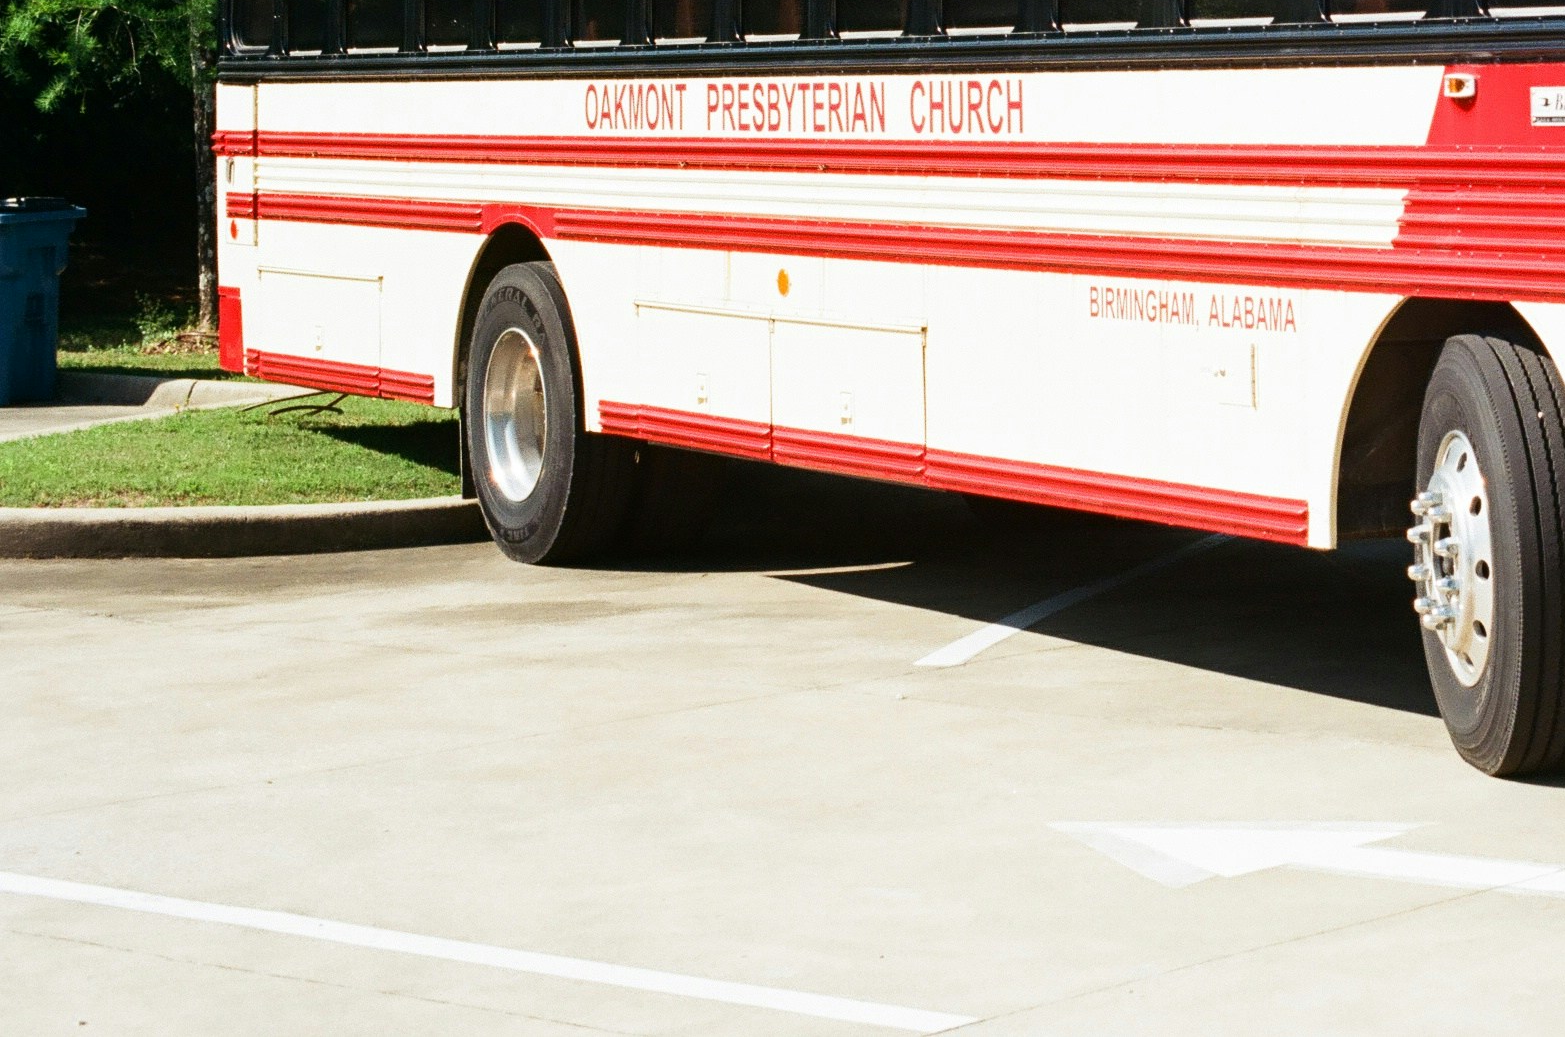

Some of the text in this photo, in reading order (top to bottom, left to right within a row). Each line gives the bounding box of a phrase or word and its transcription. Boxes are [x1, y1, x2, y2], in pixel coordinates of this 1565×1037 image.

[585, 79, 1024, 134] OAKMONT PRESBYTERIAN CHURCH
[1208, 294, 1297, 332] ALABAMA
